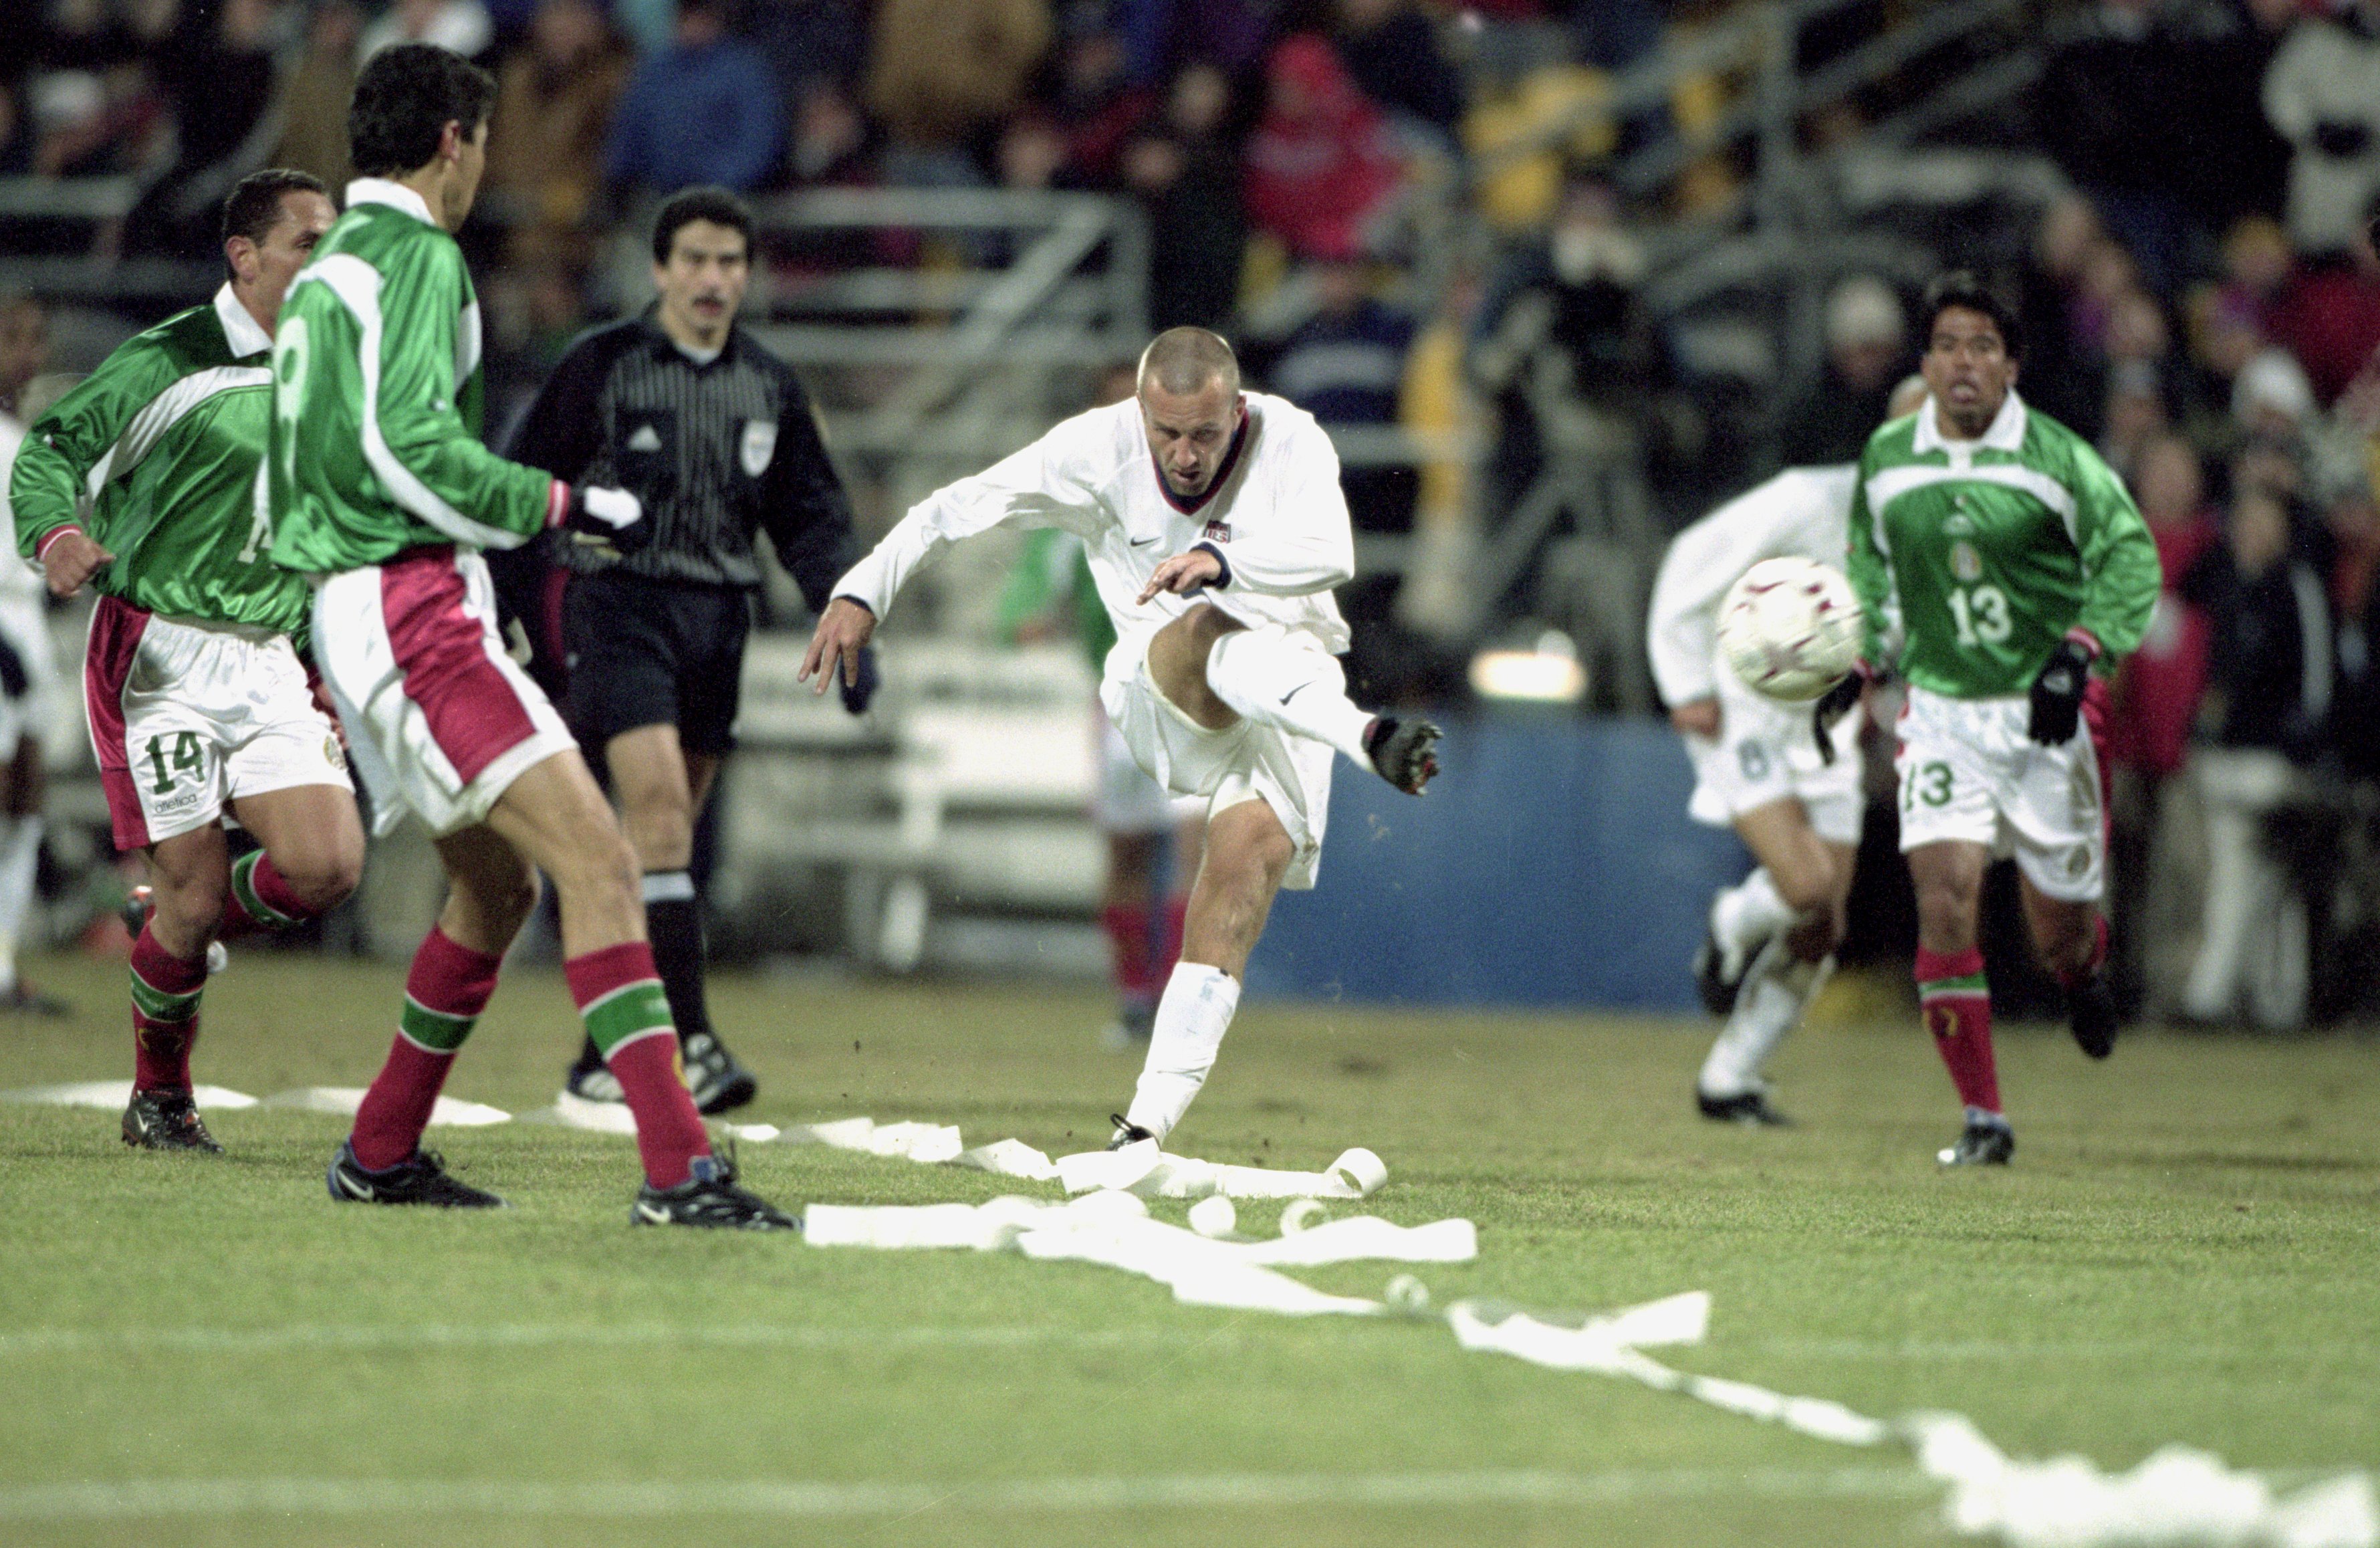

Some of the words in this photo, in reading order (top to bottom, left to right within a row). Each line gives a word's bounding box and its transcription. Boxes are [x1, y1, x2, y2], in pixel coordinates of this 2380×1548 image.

[1947, 584, 2012, 645] 13
[145, 730, 205, 794] 14
[1905, 760, 1953, 812] 13
[155, 794, 197, 814] atletica
